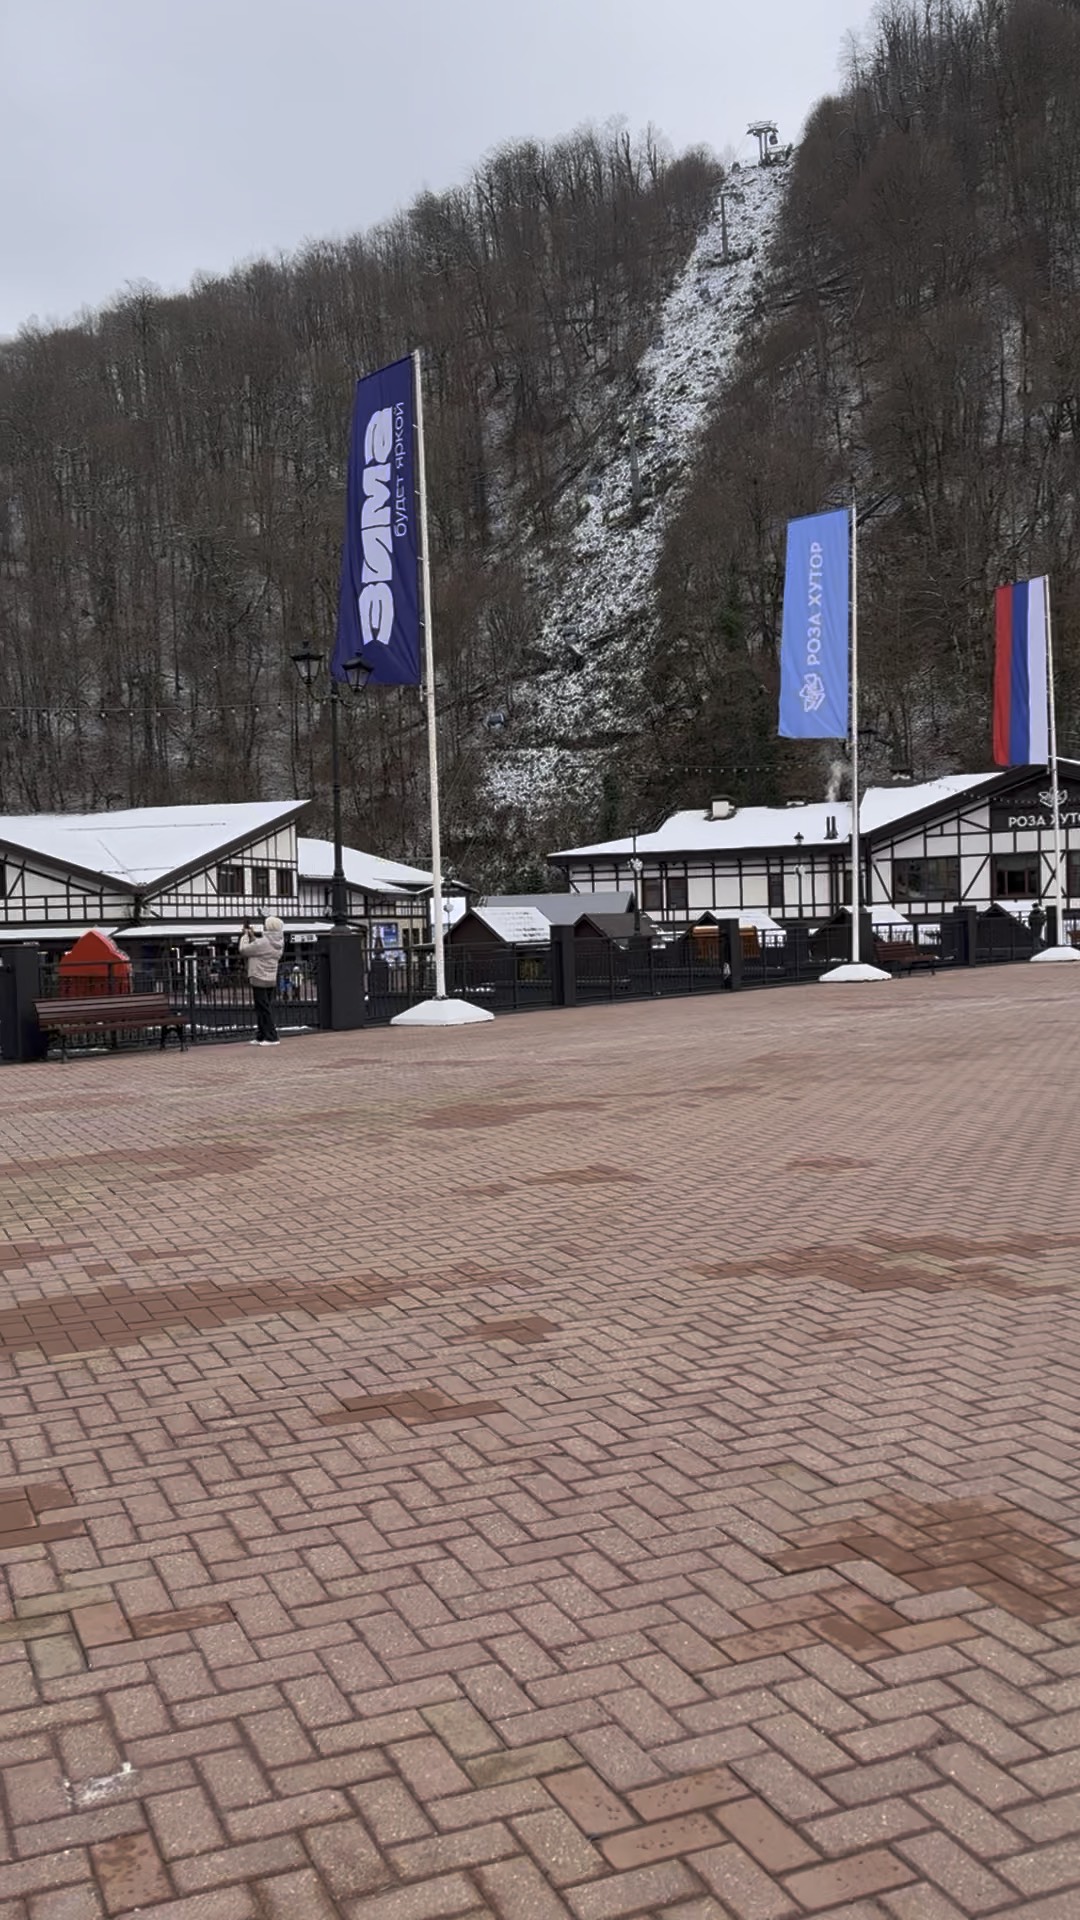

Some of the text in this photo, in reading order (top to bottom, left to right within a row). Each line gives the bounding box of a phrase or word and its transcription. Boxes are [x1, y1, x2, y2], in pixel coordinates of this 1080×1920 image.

[393, 402, 408, 537] будет яркой
[807, 541, 824, 666] РОЗА ХУТОР
[1008, 812, 1080, 828] РОЗА ХУТ
